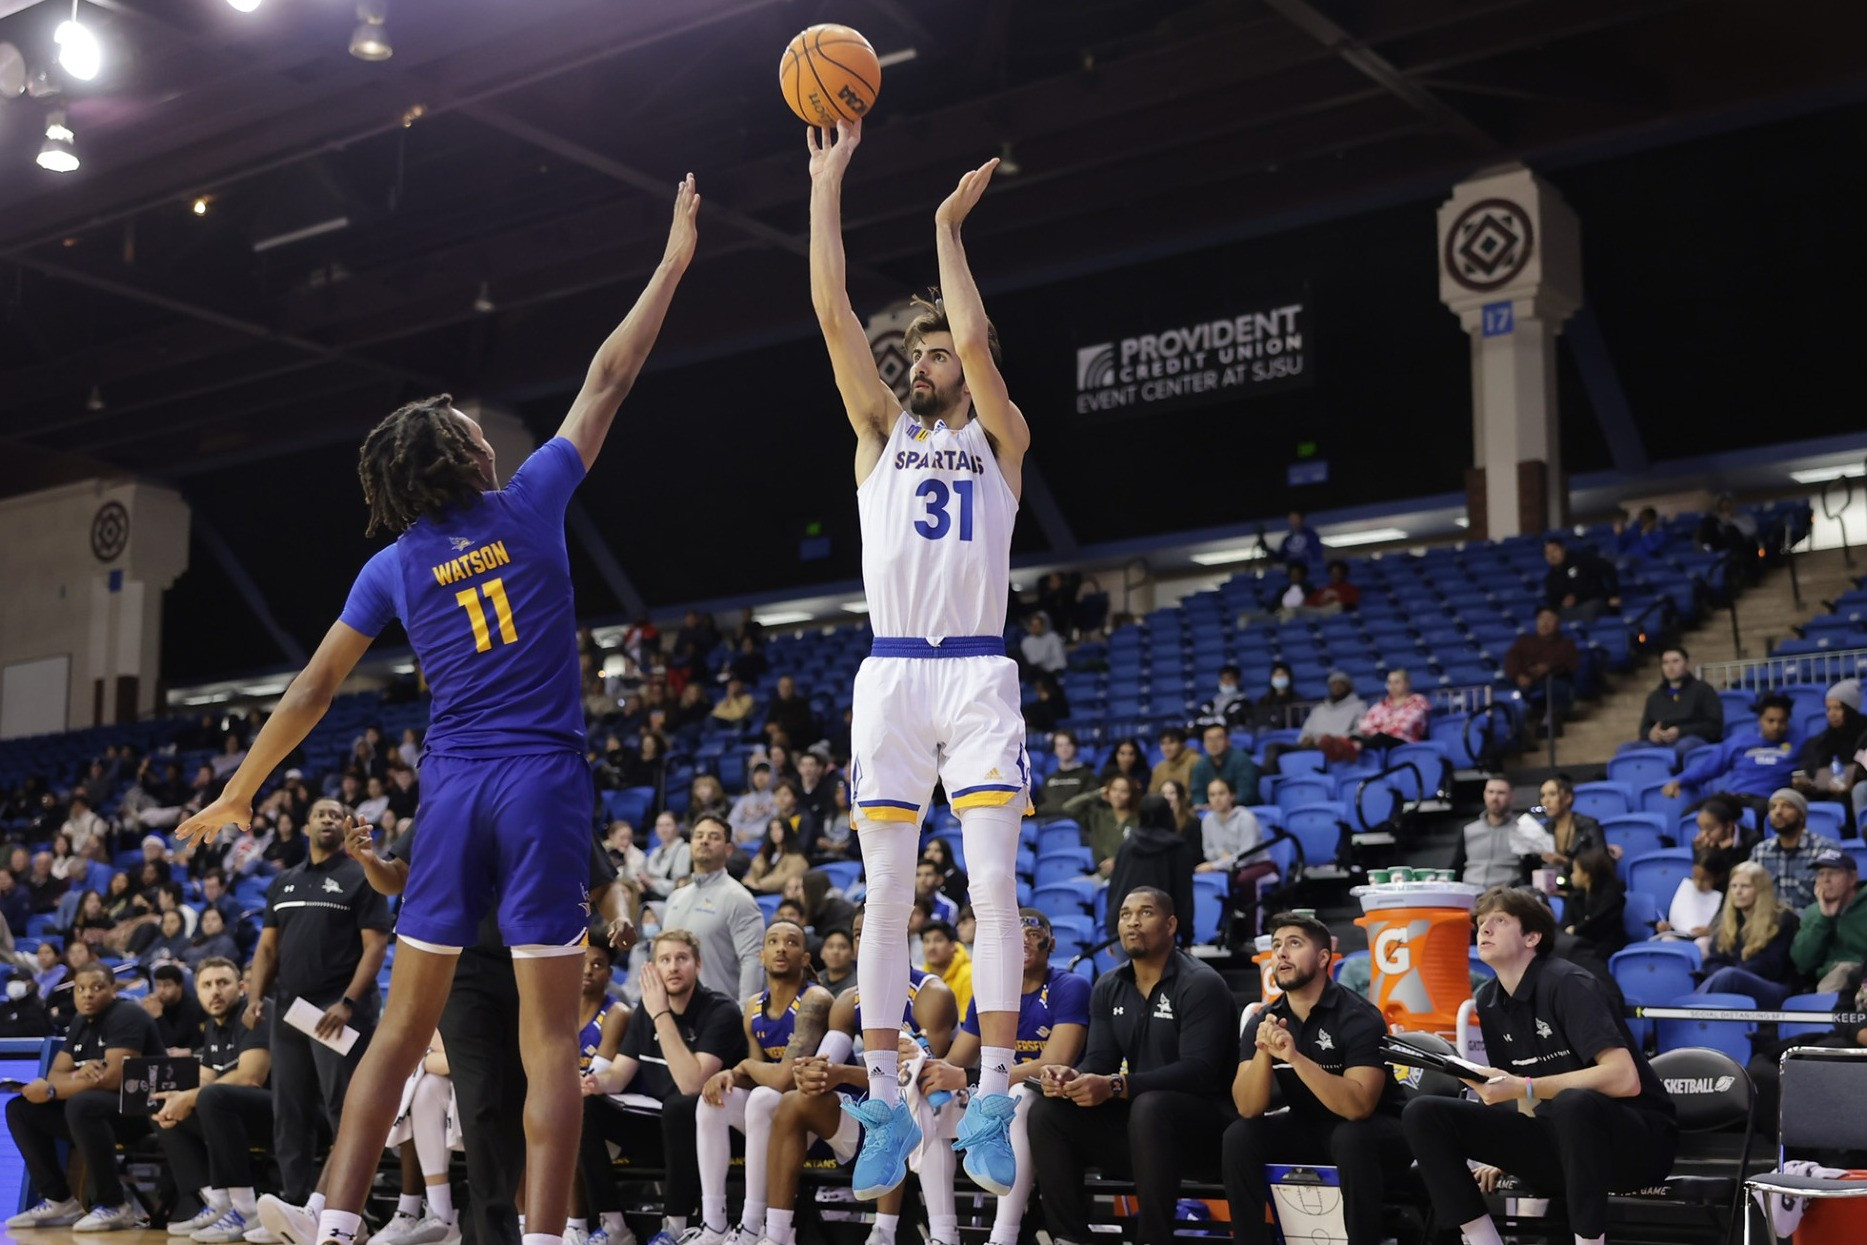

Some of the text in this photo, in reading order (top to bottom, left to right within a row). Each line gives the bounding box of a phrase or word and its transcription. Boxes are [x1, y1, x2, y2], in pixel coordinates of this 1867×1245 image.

[1120, 304, 1304, 366] PROVIDENT
[1485, 306, 1510, 333] 17
[1119, 335, 1303, 384] CREDIT UNION
[1076, 354, 1304, 414] EVENT CENTER AT SJSU
[914, 478, 973, 541] 31
[432, 540, 511, 587] WATSON
[455, 577, 519, 653] 11
[1374, 927, 1410, 975] G
[1832, 1013, 1866, 1023] KEEP
[1660, 1078, 1714, 1094] SKETBALL
